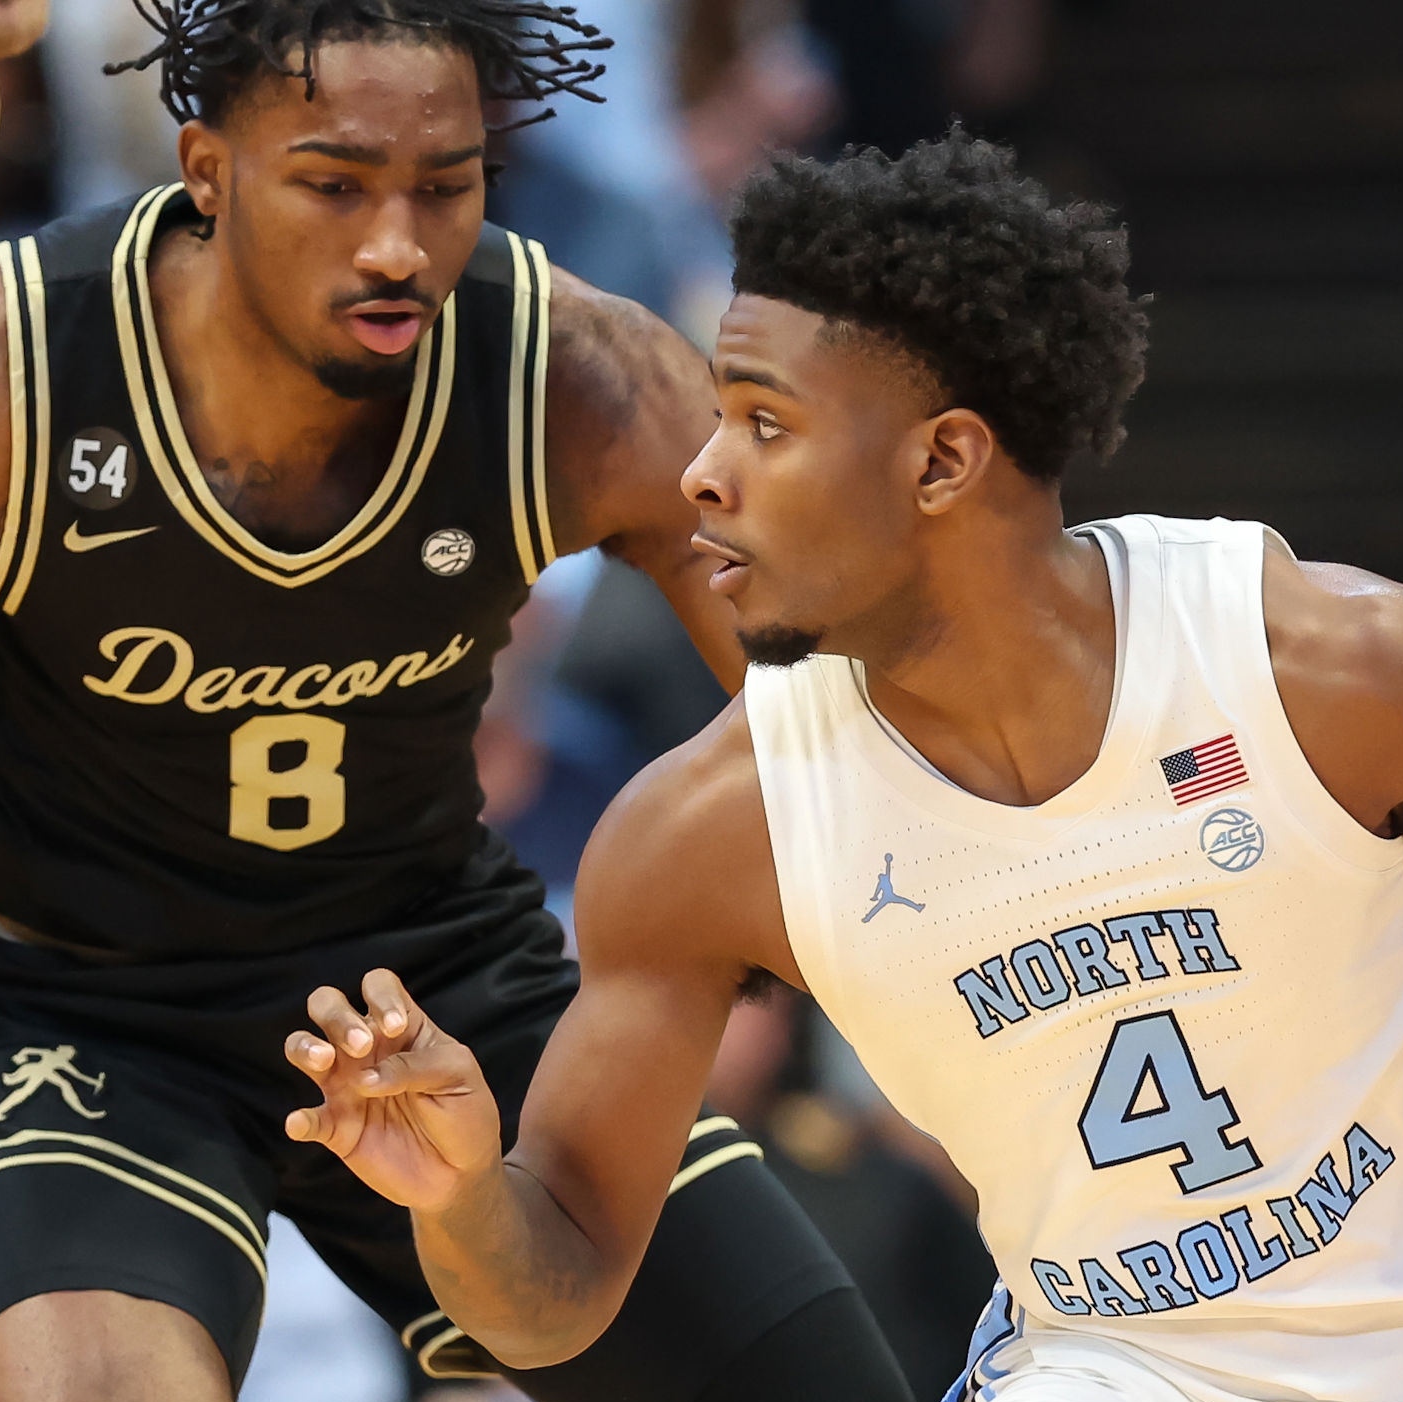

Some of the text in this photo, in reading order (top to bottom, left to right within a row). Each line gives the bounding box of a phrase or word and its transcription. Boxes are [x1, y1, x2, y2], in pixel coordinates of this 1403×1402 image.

[68, 438, 128, 499] 54
[83, 626, 474, 713] Deacons
[229, 713, 346, 851] 8
[953, 908, 1242, 1040] NORTH
[1076, 1008, 1264, 1196] 4
[1030, 1121, 1397, 1317] CAROLINA
